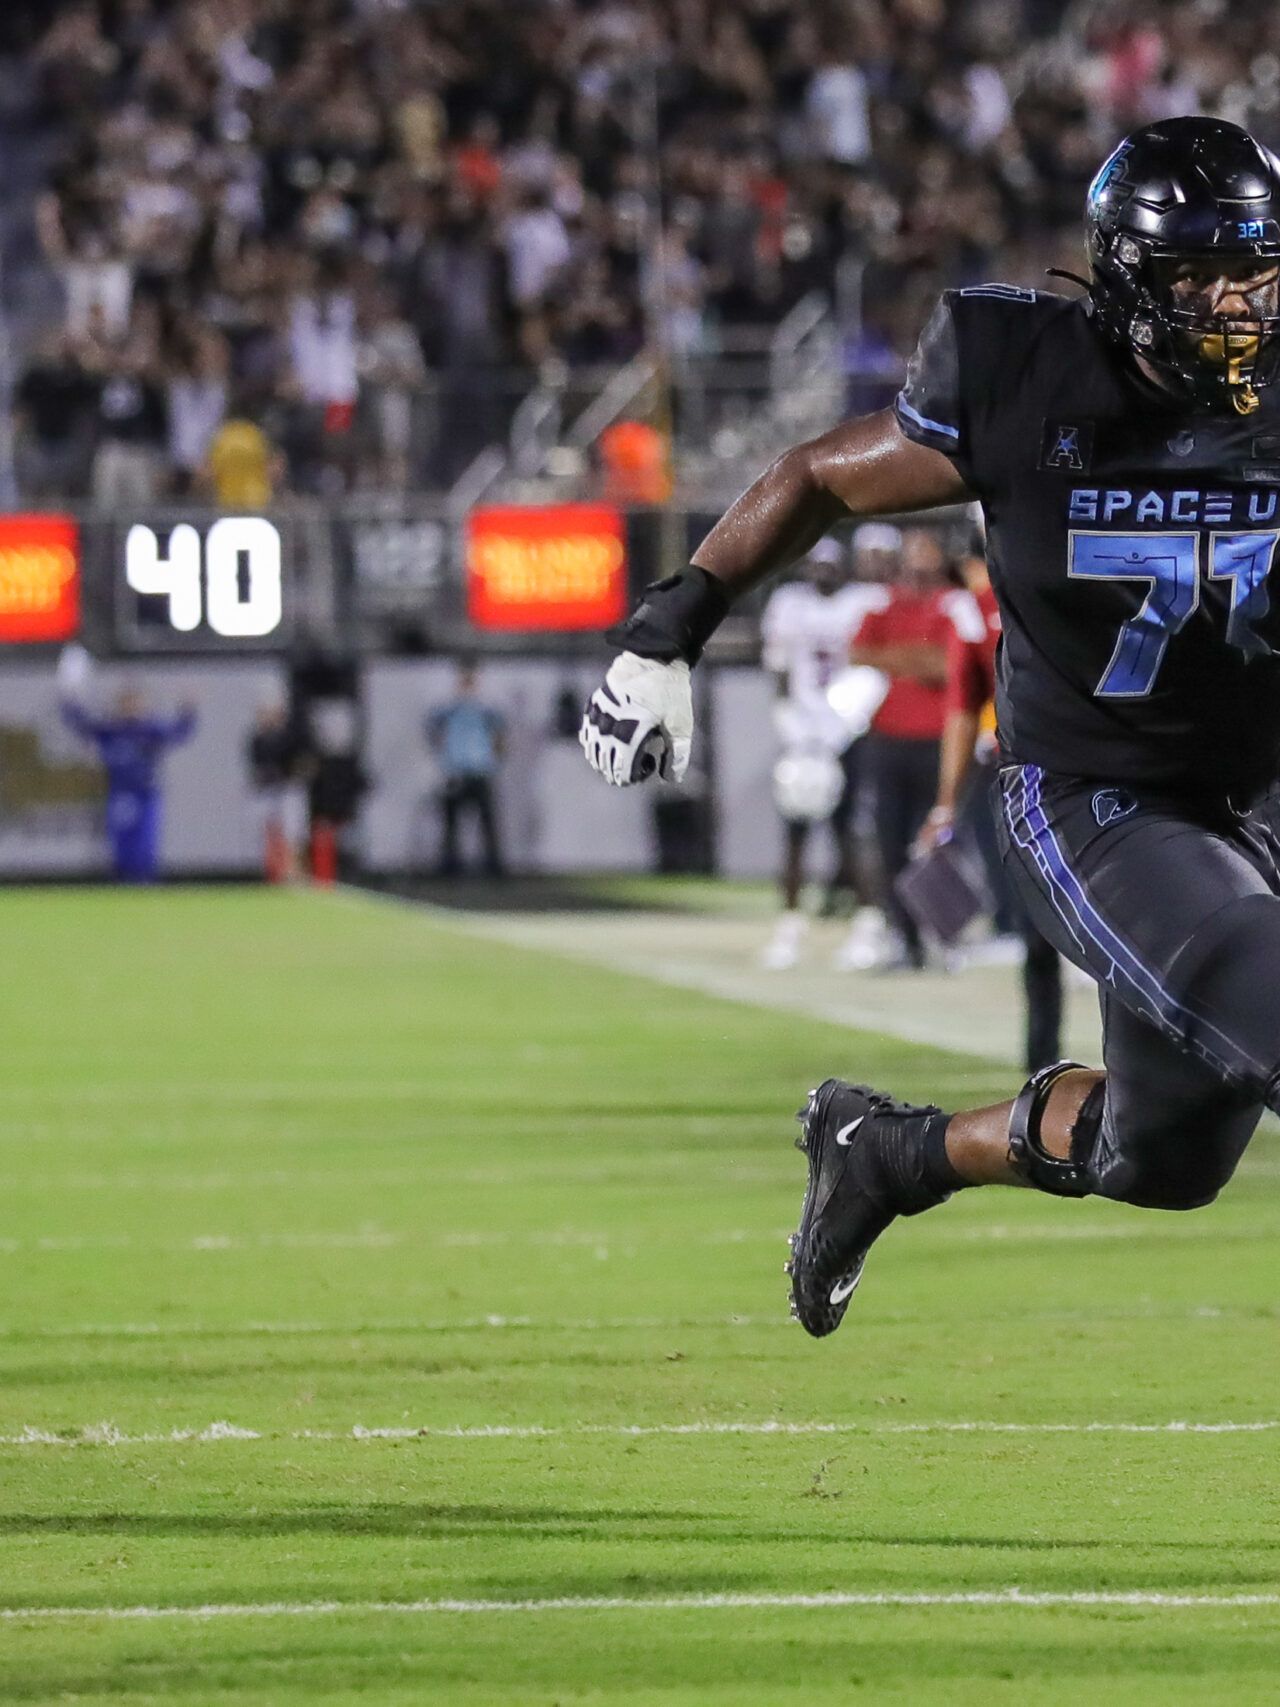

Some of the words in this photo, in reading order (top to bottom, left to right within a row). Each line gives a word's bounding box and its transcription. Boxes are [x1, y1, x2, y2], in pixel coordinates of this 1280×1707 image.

[1238, 222, 1264, 238] 321
[1068, 489, 1233, 523] SPACE
[1247, 491, 1278, 522] U
[126, 517, 282, 636] 40
